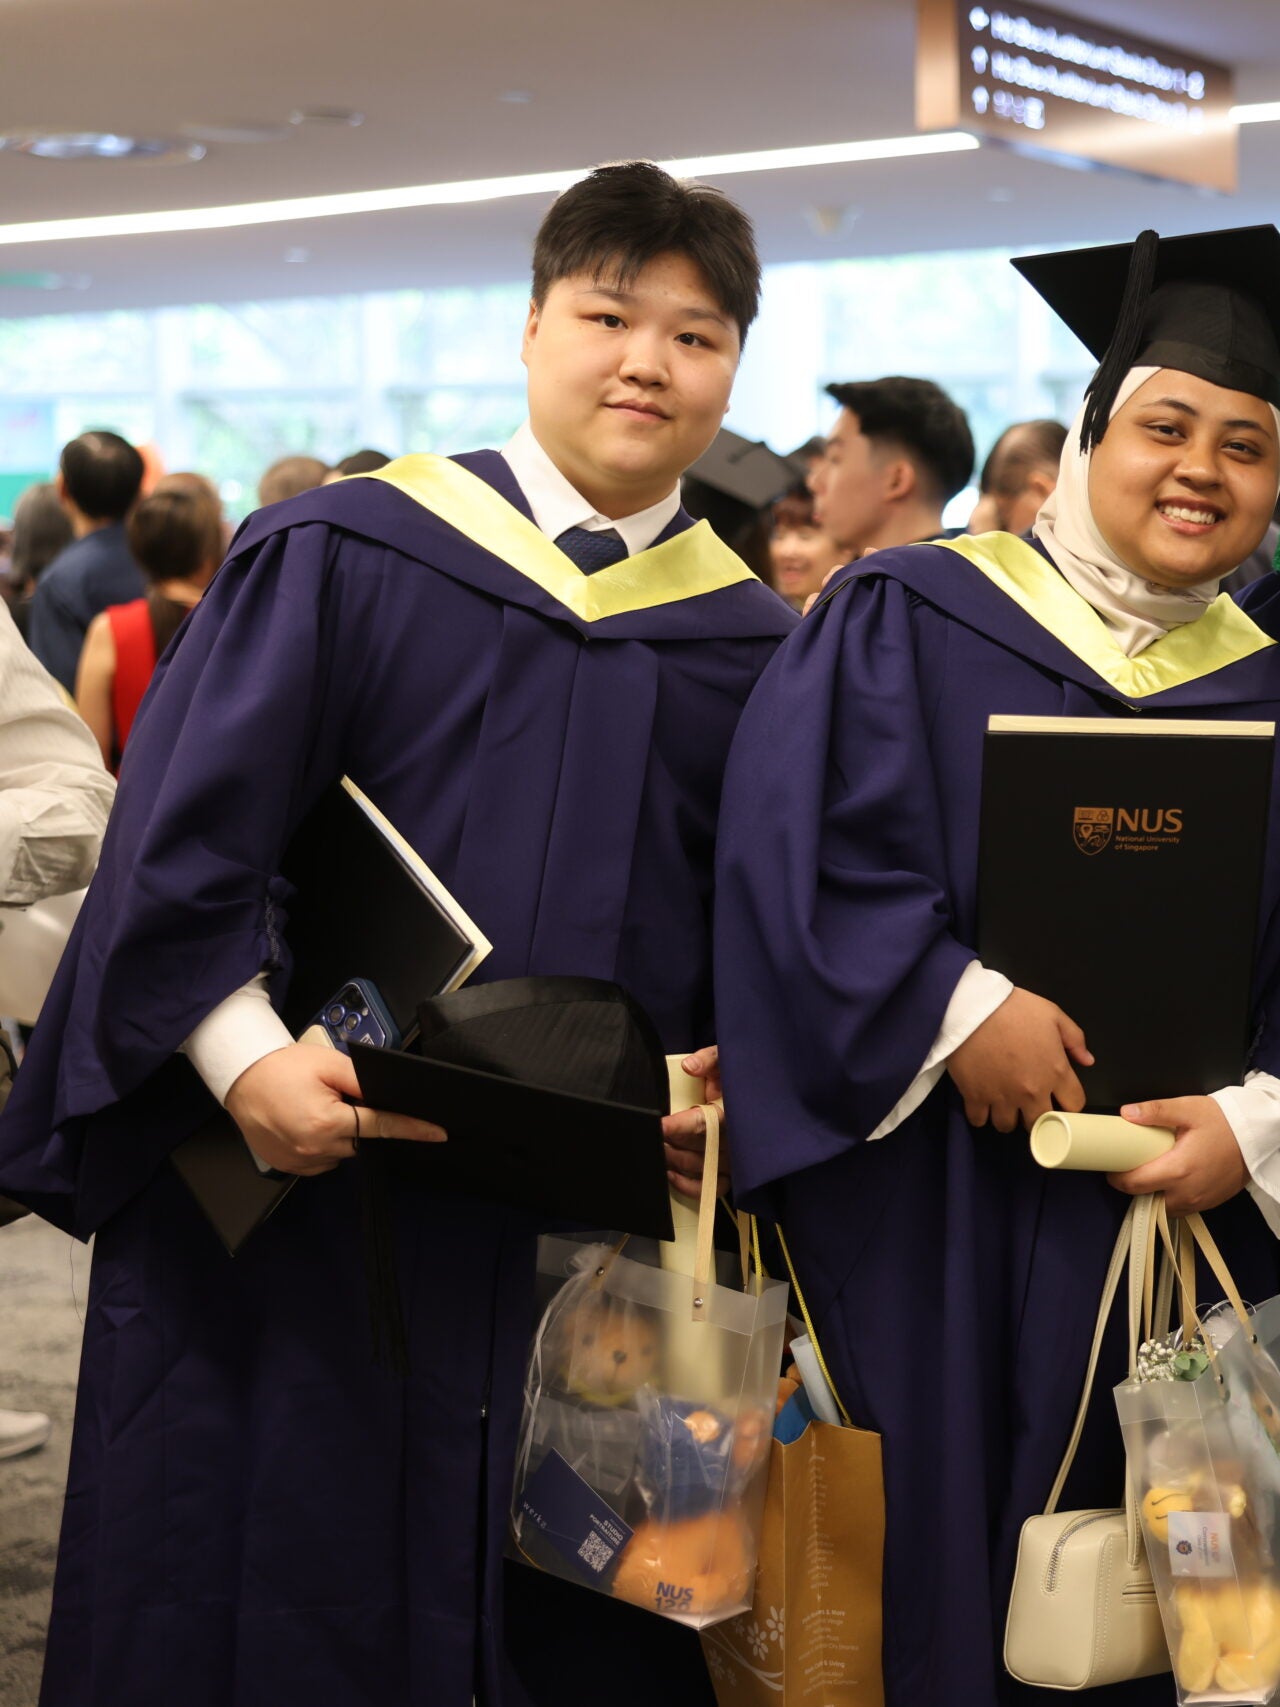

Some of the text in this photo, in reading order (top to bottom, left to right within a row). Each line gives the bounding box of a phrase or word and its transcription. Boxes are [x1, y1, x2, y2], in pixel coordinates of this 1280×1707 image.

[1116, 807, 1184, 833] NUS
[1115, 835, 1180, 845] National University
[1123, 844, 1158, 852] Singapore
[589, 1513, 621, 1546] PORTRAITURE
[602, 1519, 624, 1541] STUDIO
[656, 1581, 695, 1602] NUS
